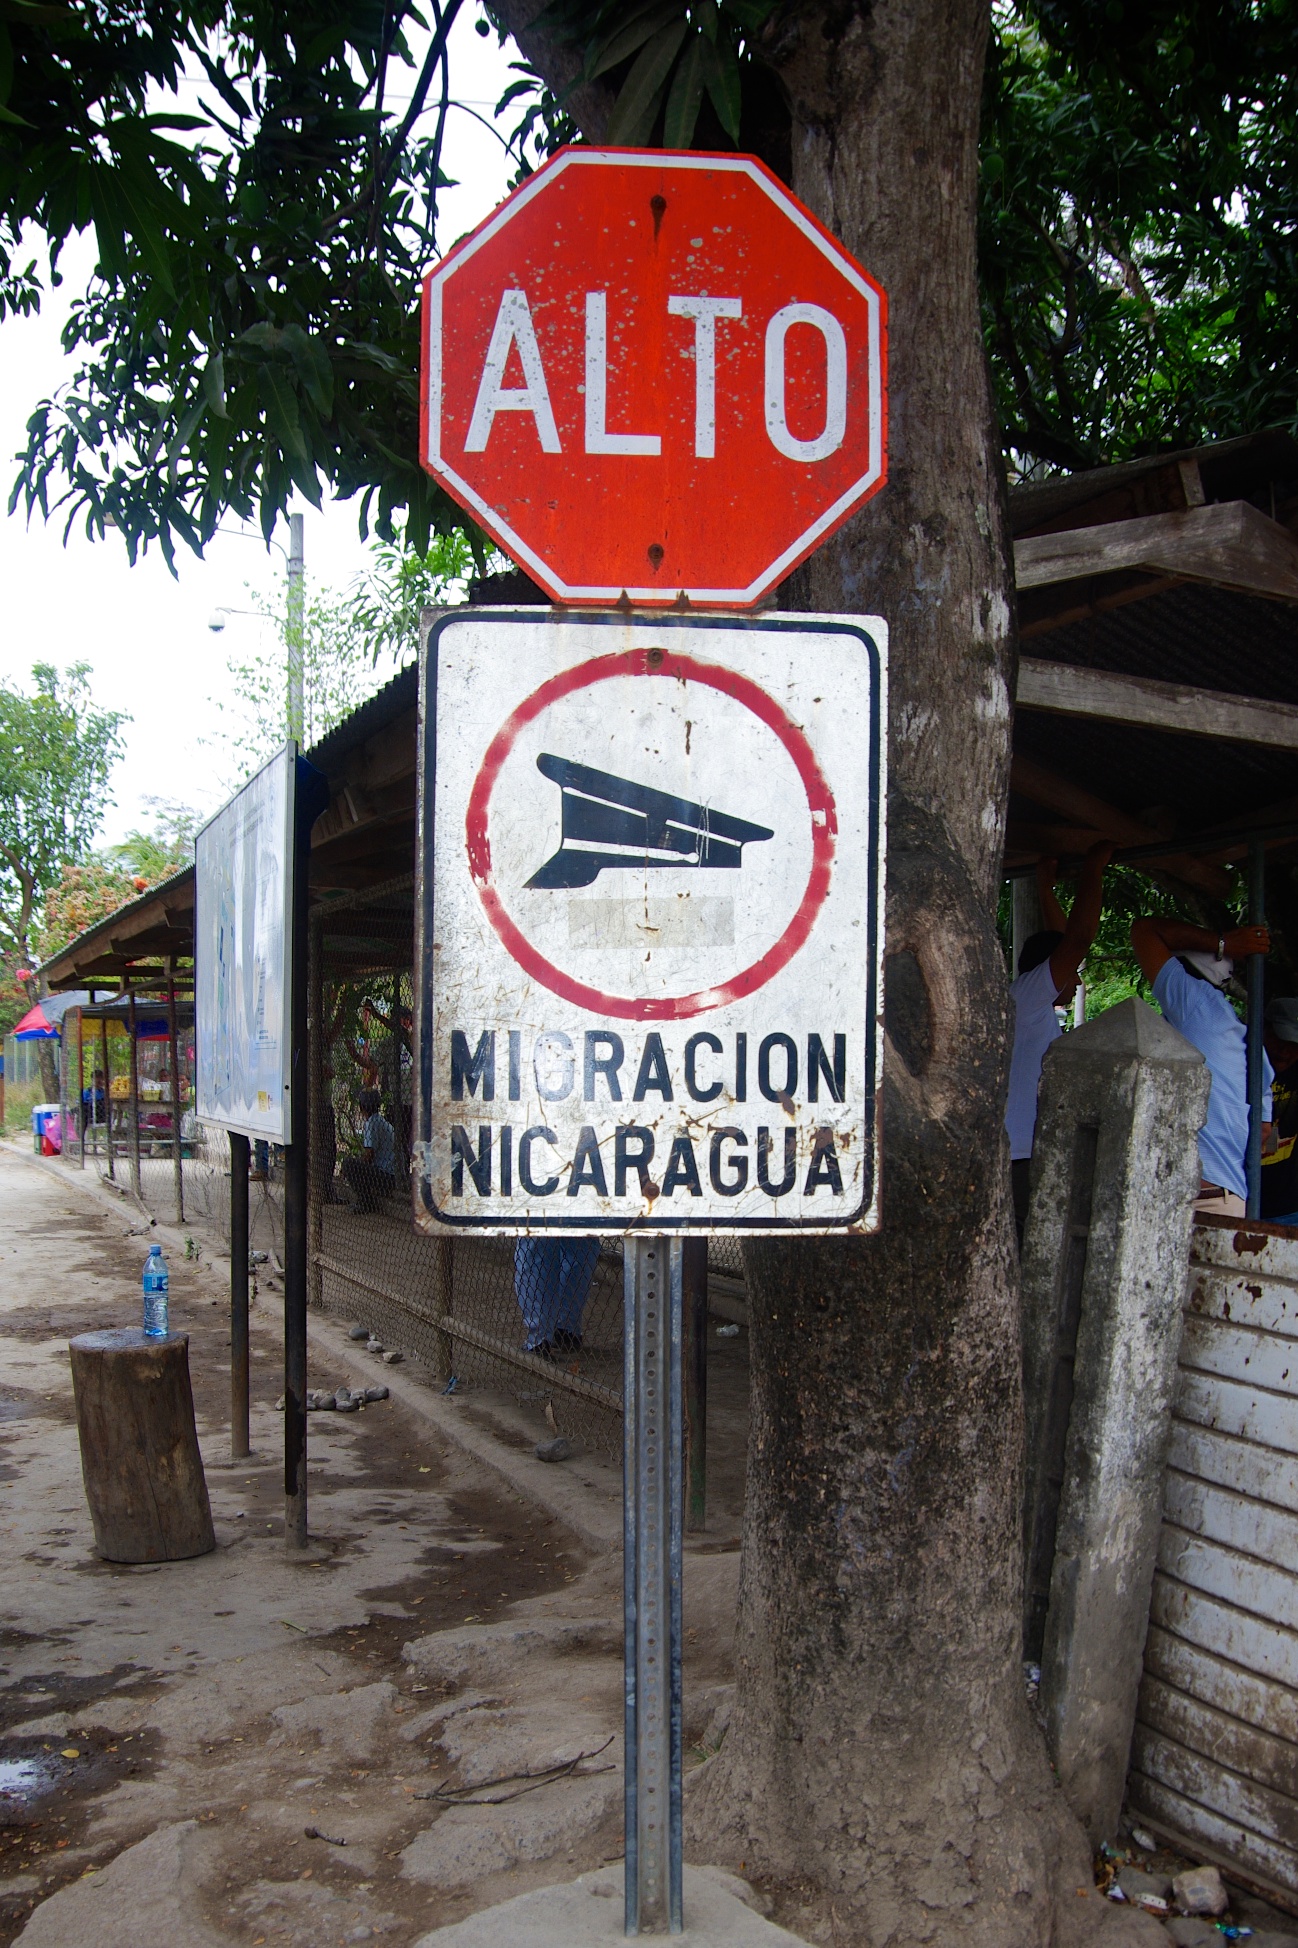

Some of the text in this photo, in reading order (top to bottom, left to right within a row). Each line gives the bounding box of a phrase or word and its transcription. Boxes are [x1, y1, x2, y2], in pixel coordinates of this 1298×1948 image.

[463, 289, 847, 463] ALTO
[450, 1029, 847, 1104] MIGRACION
[450, 1124, 844, 1198] NICARAGUA
